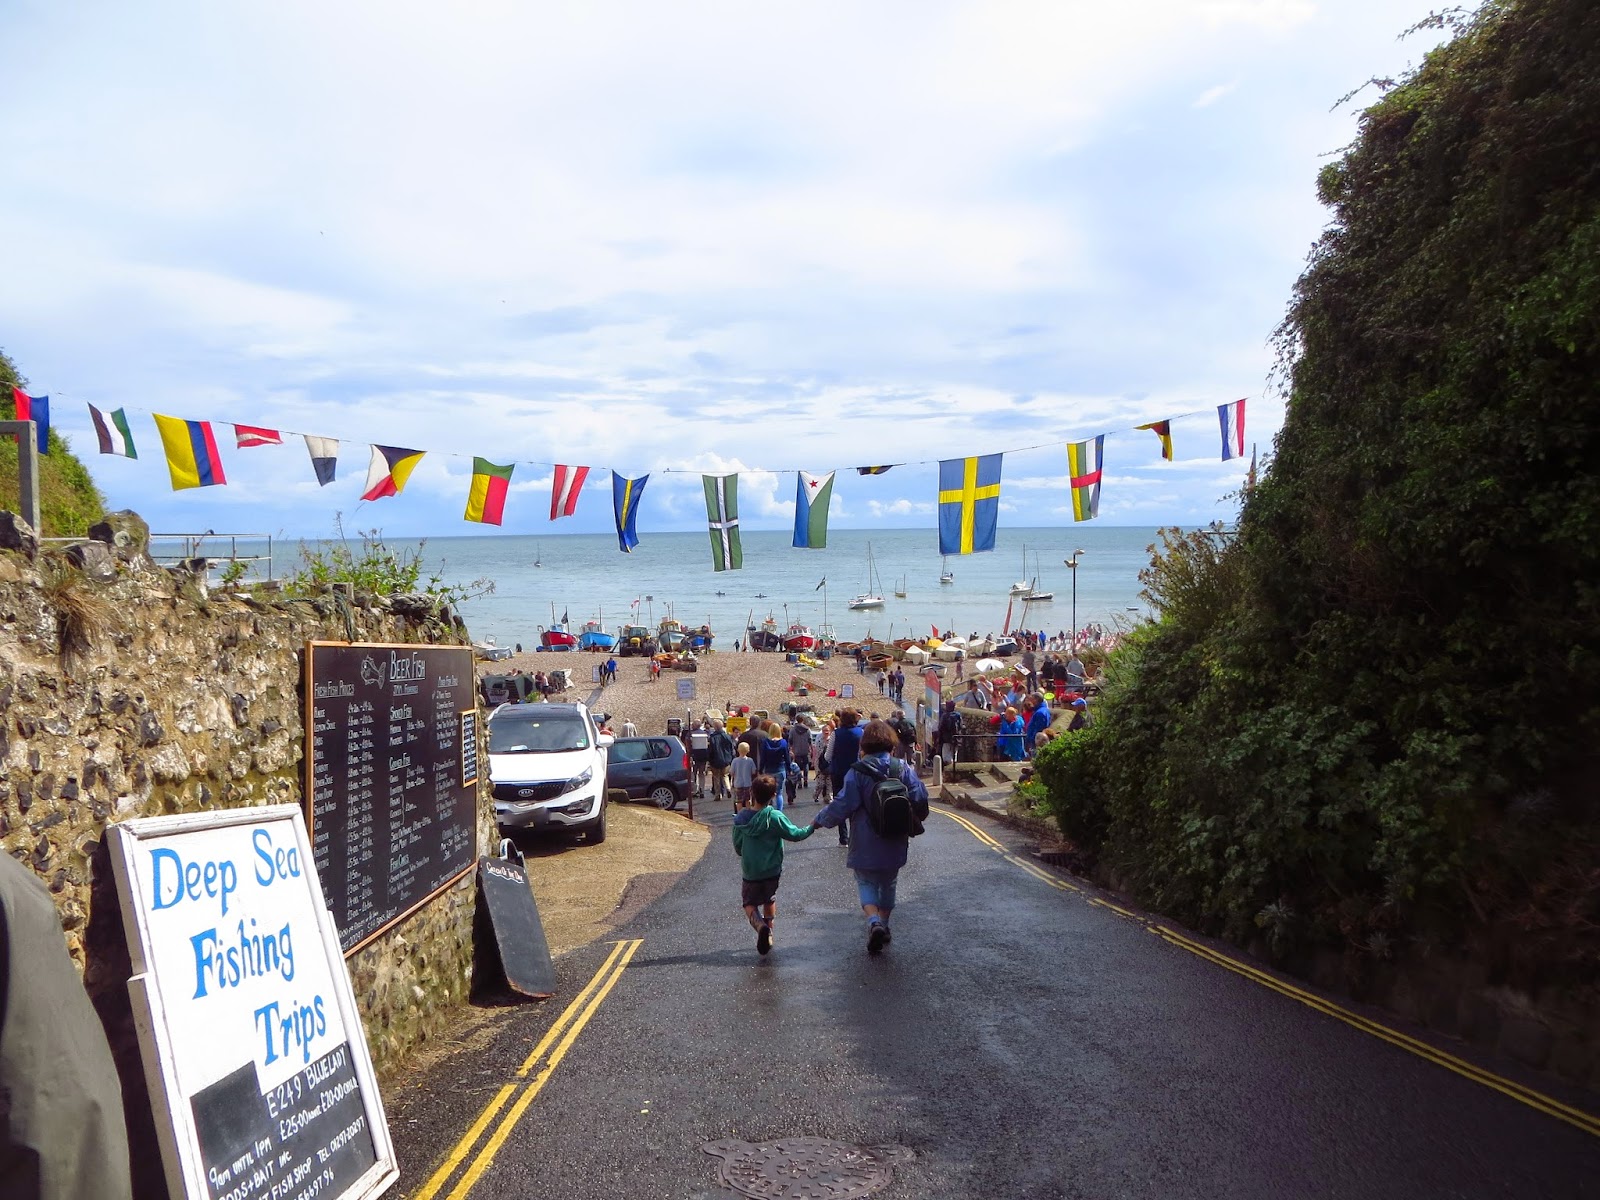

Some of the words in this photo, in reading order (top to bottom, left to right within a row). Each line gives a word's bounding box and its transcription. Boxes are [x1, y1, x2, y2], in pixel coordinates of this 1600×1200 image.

[390, 650, 411, 680] BEER
[411, 652, 426, 679] FISH
[148, 847, 237, 917] Deep
[252, 828, 301, 887] Sea
[190, 918, 295, 1000] Fishing
[254, 994, 326, 1066] Trips
[209, 1166, 231, 1190] 9am
[232, 1151, 254, 1175] UNTIL
[271, 1172, 294, 1200] FISH
[293, 1156, 312, 1184] SHOP
